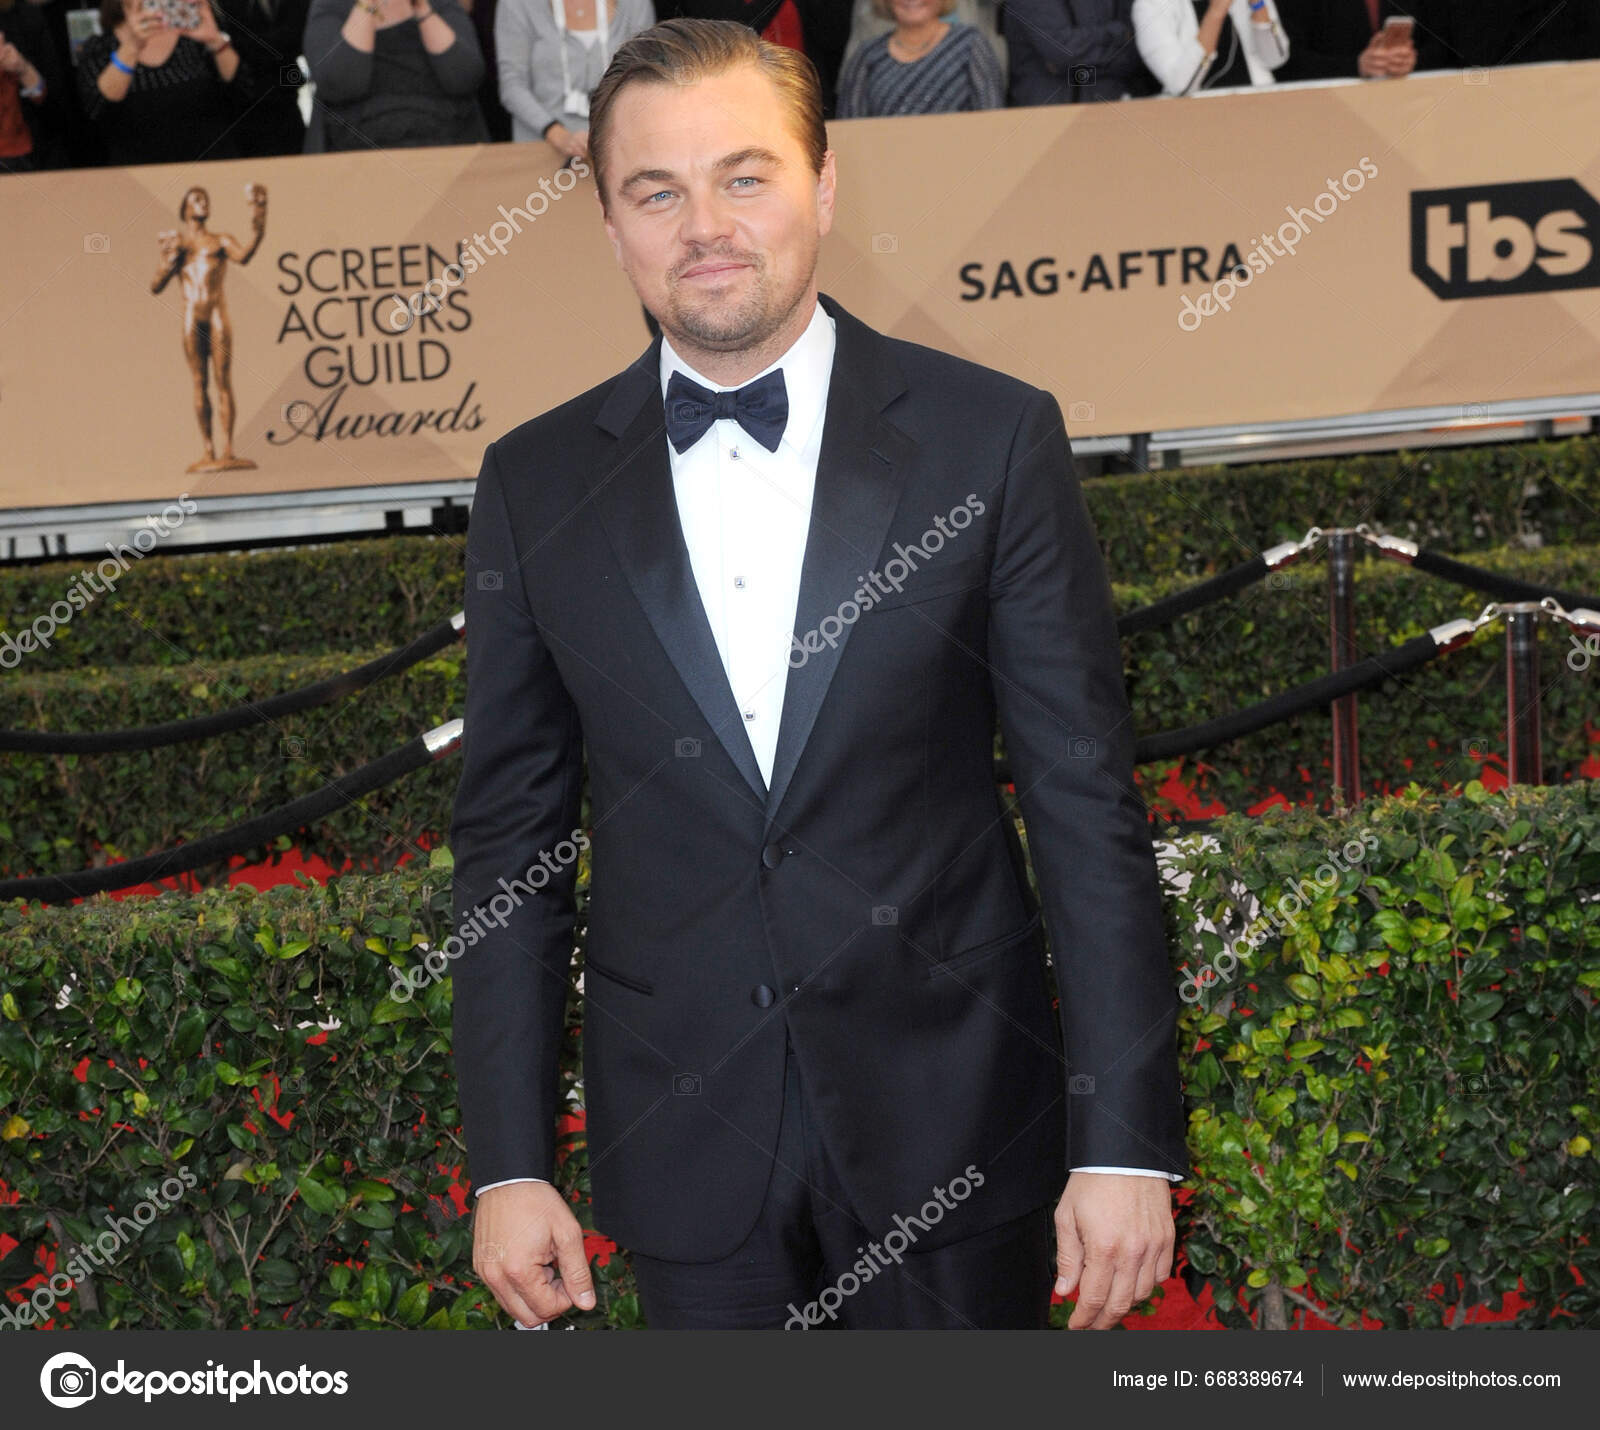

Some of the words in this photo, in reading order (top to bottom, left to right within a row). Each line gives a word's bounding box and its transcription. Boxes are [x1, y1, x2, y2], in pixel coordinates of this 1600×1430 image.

[277, 241, 464, 296] SCREEN
[1426, 200, 1592, 283] tbs
[276, 288, 473, 344] ACTORS
[304, 339, 451, 389] GUILD
[265, 381, 487, 447] Awards
